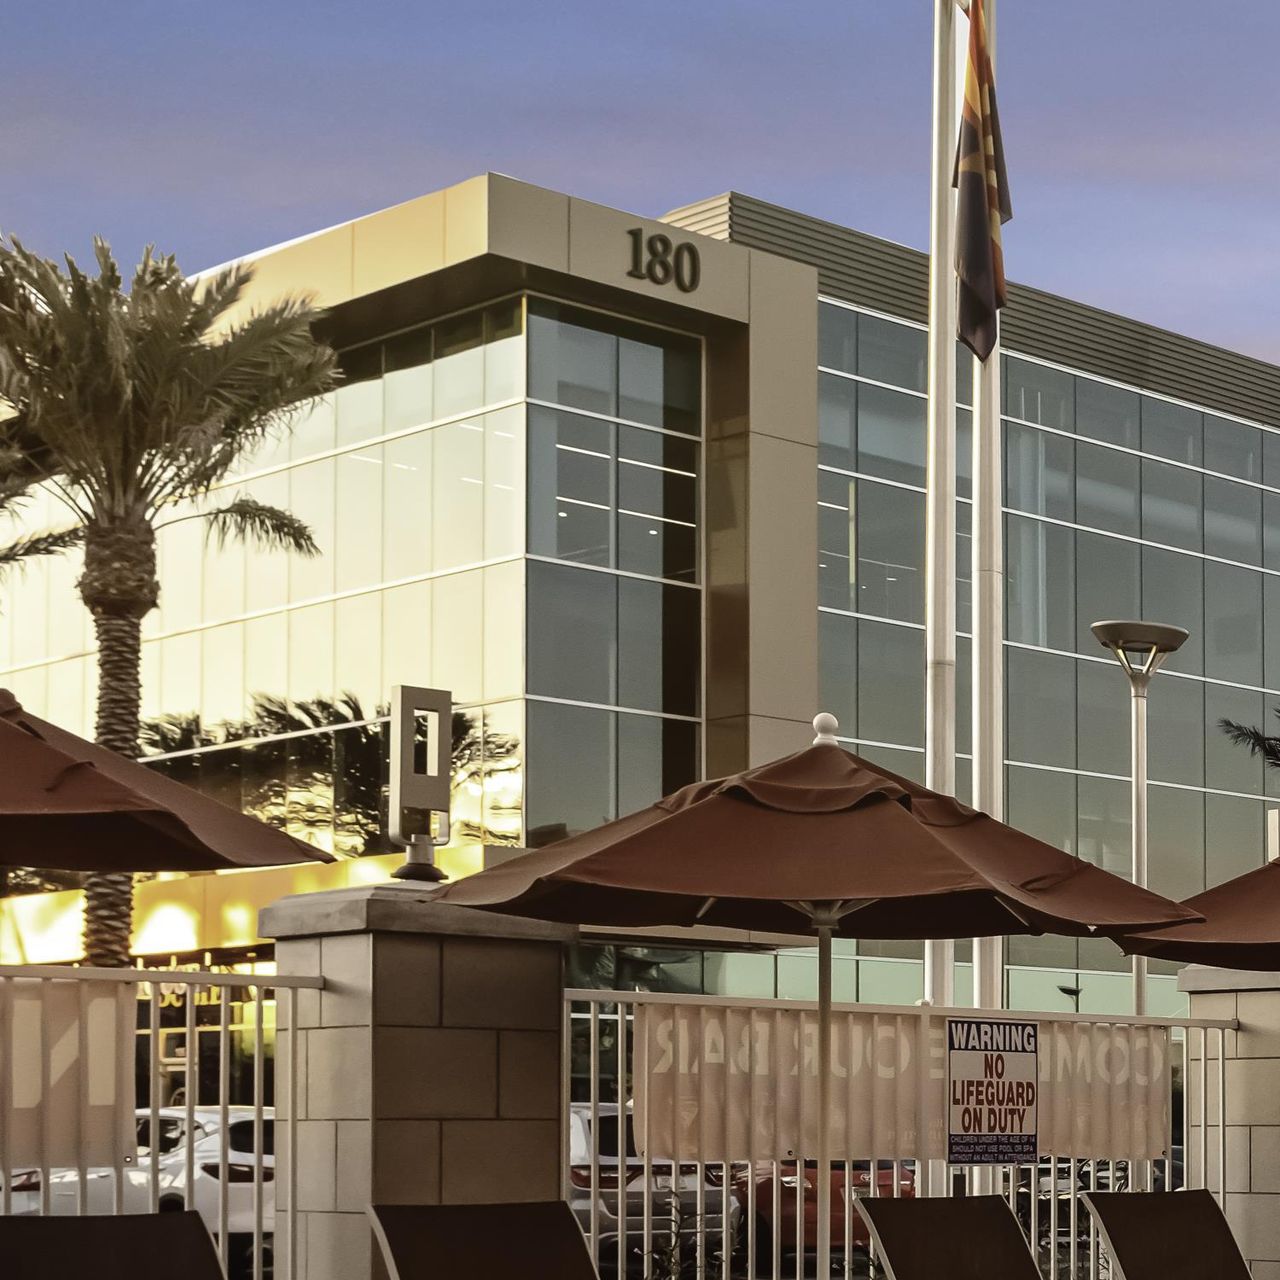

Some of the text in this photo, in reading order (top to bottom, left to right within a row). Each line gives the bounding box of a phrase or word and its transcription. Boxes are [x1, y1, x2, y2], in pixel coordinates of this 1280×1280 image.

[626, 228, 701, 294] 180
[951, 1022, 1035, 1052] WARNING
[984, 1053, 1005, 1079] NO
[952, 1080, 1036, 1107] LIFEGUARD
[961, 1107, 983, 1133] ON
[987, 1108, 1026, 1133] DUTY
